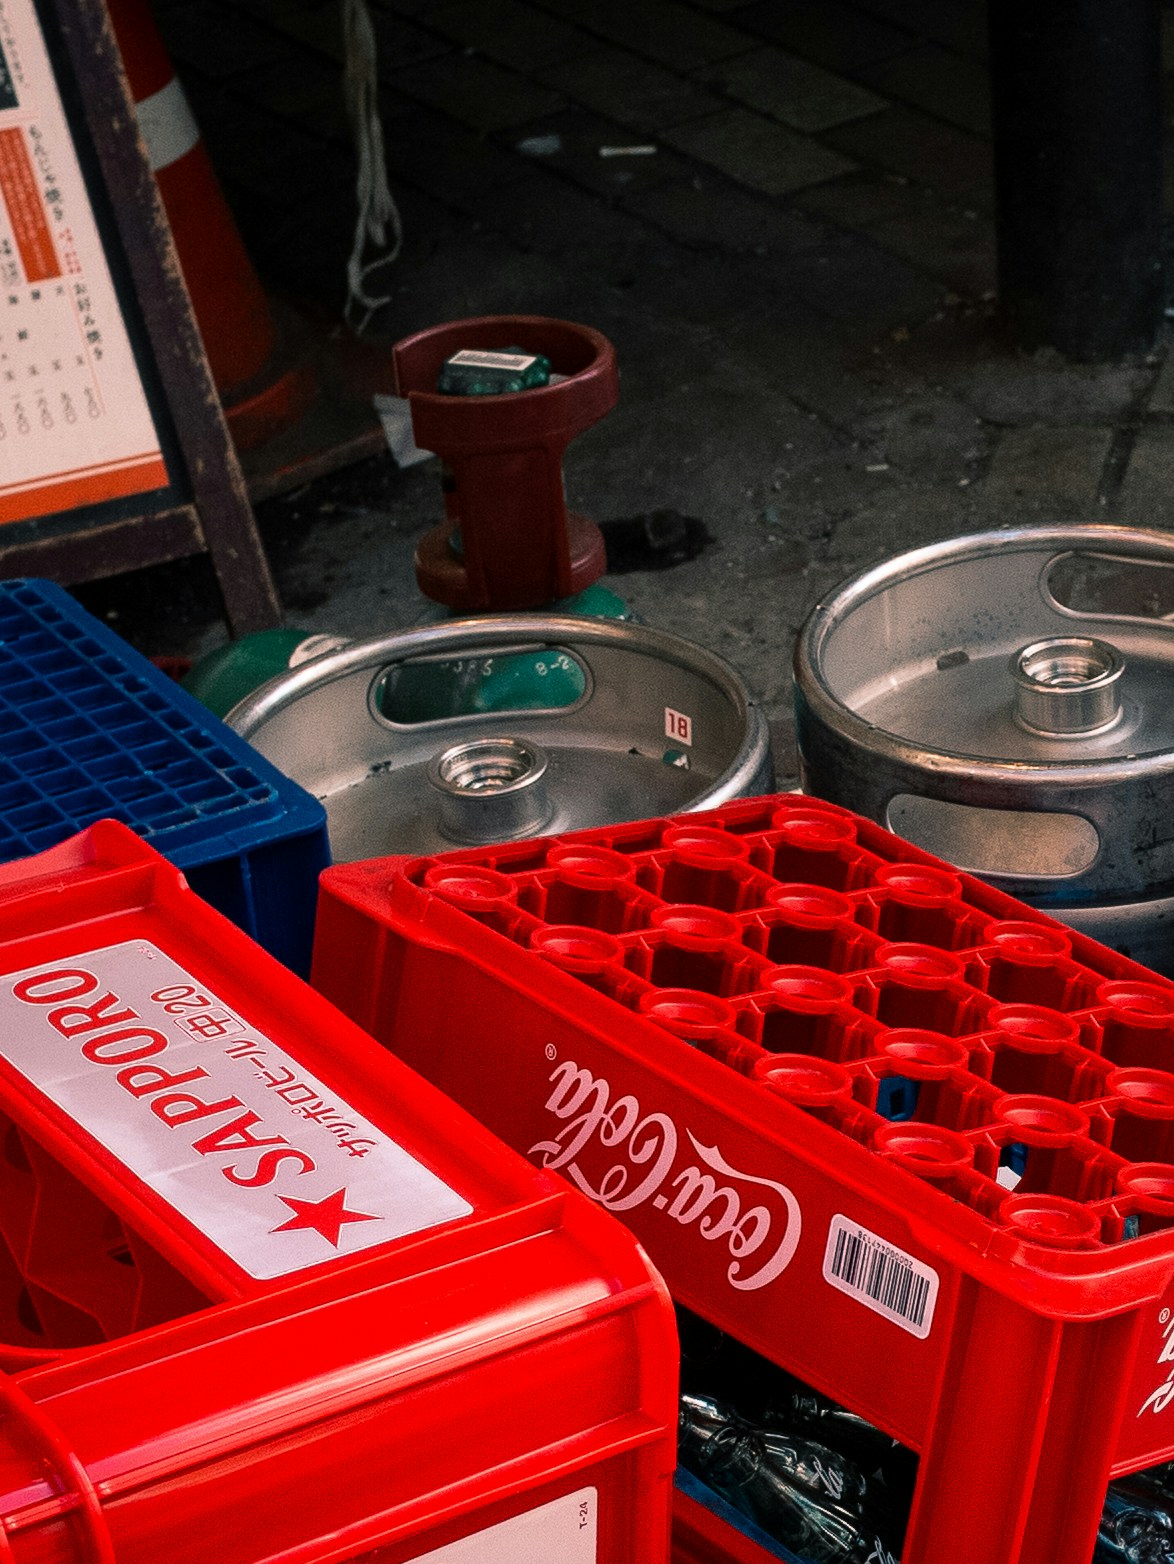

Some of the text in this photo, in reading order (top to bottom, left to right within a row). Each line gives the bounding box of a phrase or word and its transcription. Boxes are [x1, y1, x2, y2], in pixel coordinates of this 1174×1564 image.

[668, 712, 687, 738] 18
[12, 967, 318, 1189] SAPPORO
[224, 1039, 378, 1158] サッポロビール
[527, 1060, 802, 1291] Coca-Cola
